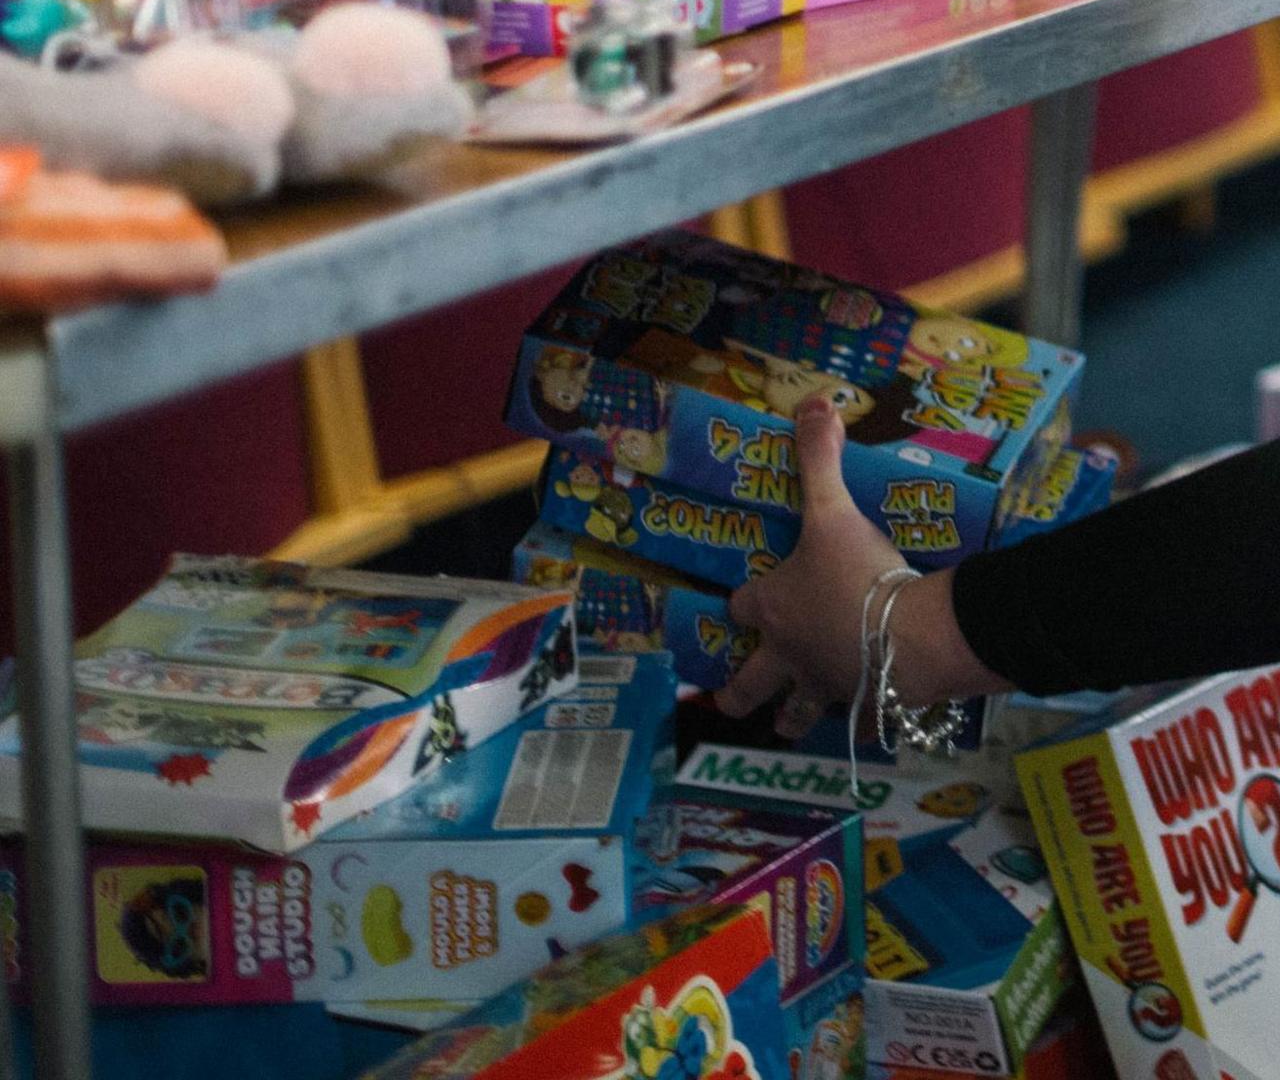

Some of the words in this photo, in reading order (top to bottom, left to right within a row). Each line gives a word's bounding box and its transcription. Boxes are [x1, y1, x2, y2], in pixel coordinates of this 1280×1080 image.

[707, 416, 743, 464] 4
[740, 427, 799, 477] UP
[731, 460, 802, 513] INE
[880, 480, 957, 515] PLAY
[640, 491, 771, 551] WHO?
[887, 517, 962, 553] PICK
[694, 614, 728, 659] 4
[690, 752, 893, 812] Matching
[1131, 706, 1236, 827] WHO
[1060, 755, 1118, 837] WHO
[1090, 843, 1143, 916] ARE
[231, 864, 260, 977] DOUGH
[255, 883, 283, 962] HAIR
[282, 863, 314, 980] STUDIO
[431, 893, 452, 967] MOULD
[453, 881, 472, 962] FLOWER
[474, 885, 494, 939] BOW!
